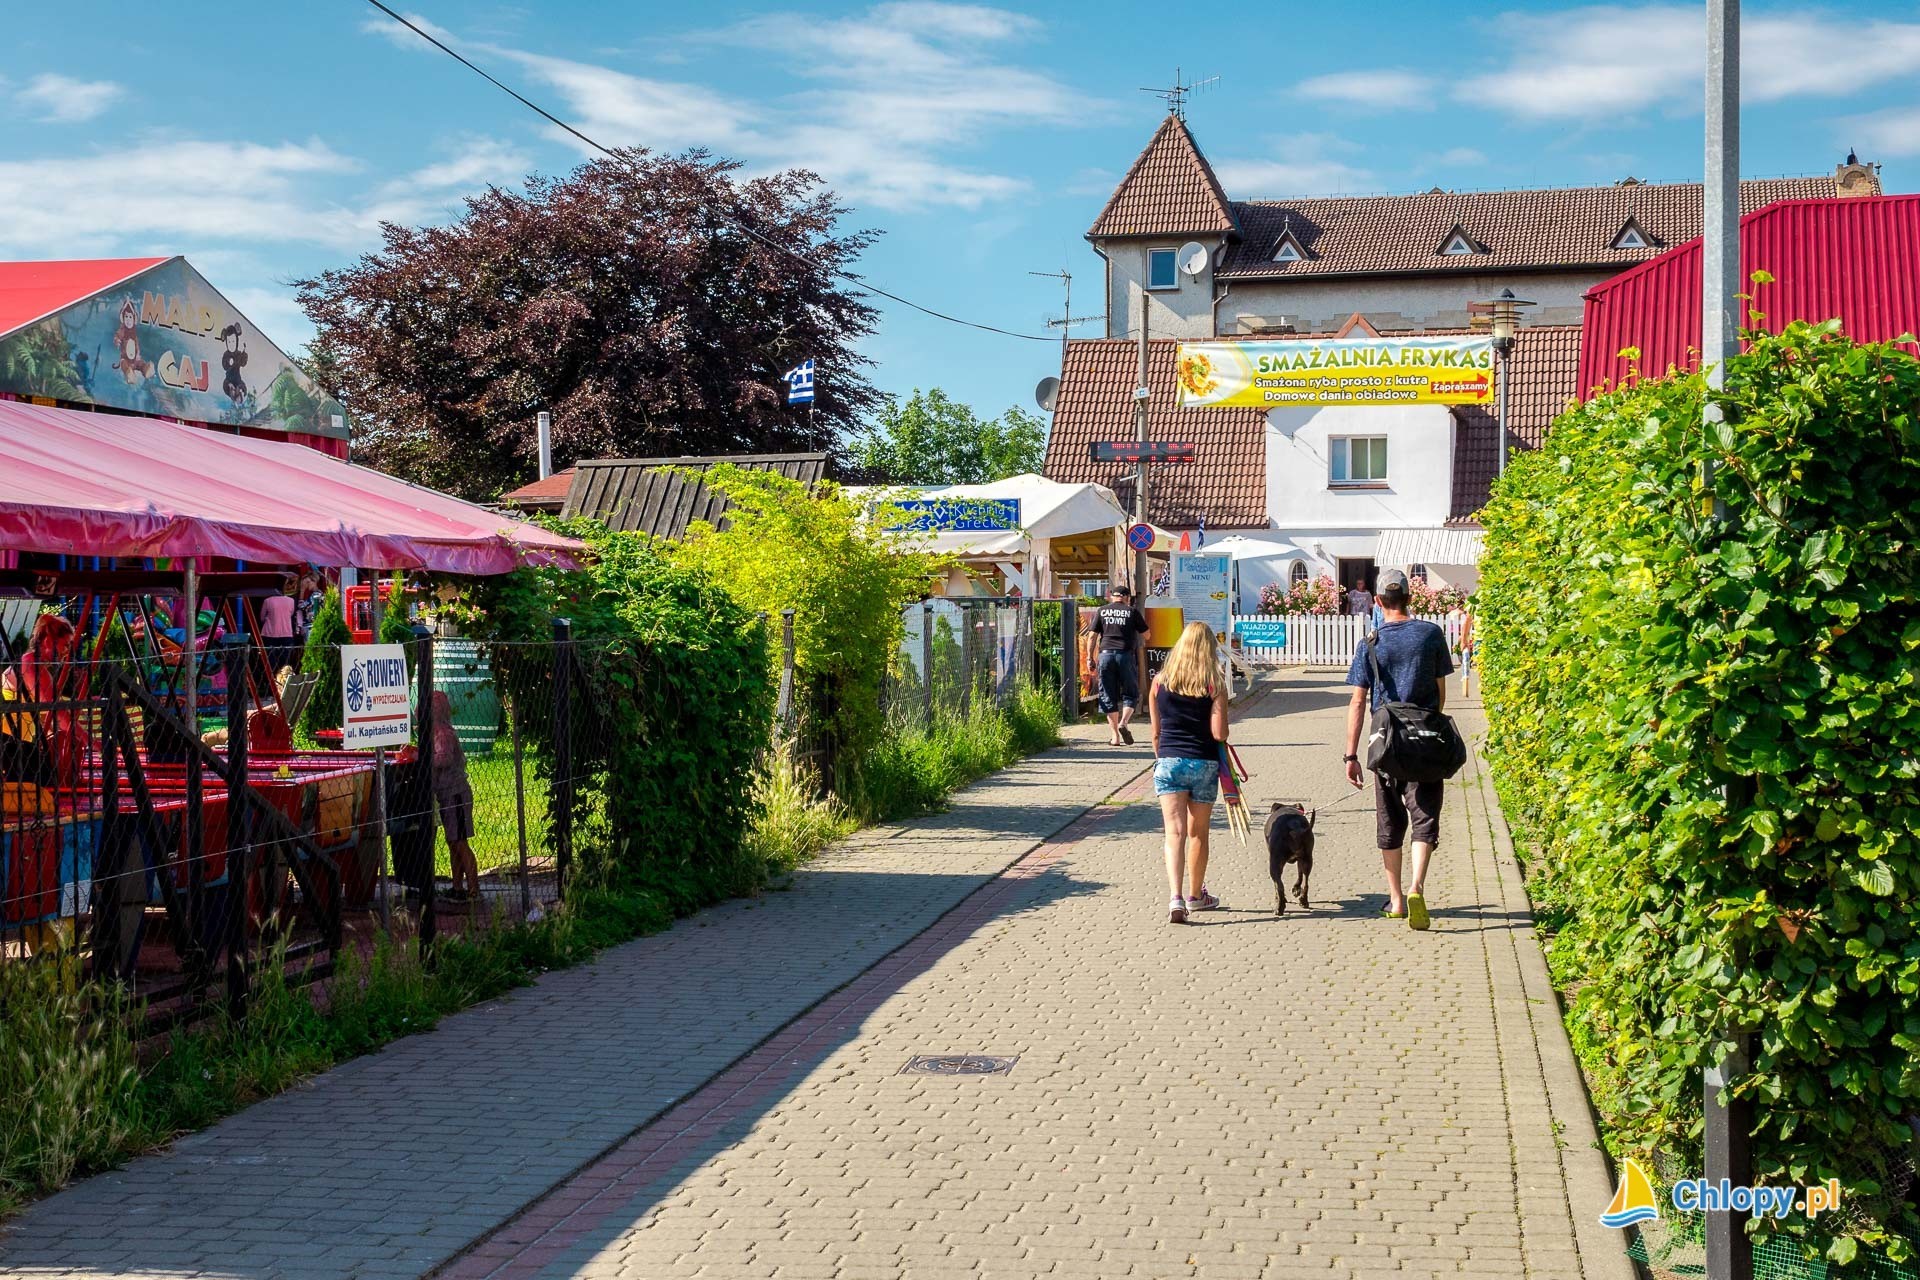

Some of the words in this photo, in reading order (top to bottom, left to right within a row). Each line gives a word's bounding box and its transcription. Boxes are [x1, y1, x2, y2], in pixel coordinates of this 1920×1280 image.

[1258, 347, 1393, 373] SMAŻALNIA
[1400, 347, 1490, 370] FRYKAS
[158, 350, 209, 392] GAJ
[1255, 376, 1307, 388] Smażona
[1309, 376, 1337, 389] ryba
[1340, 374, 1382, 388] prosto
[1385, 376, 1393, 386] z
[1395, 375, 1428, 386] kutra
[1432, 382, 1489, 393] Zapraszamy
[1264, 391, 1316, 401] Domowe
[1319, 390, 1353, 401] dania
[1355, 389, 1418, 401] obiadowe
[1100, 608, 1131, 618] CAMDEN
[1104, 616, 1126, 625] TOWN
[367, 659, 405, 688] ROWERY
[373, 694, 406, 704] WYPOŻYCZALNIA
[347, 728, 356, 738] ul.
[359, 725, 398, 738] Kapitańska
[399, 723, 407, 733] 58
